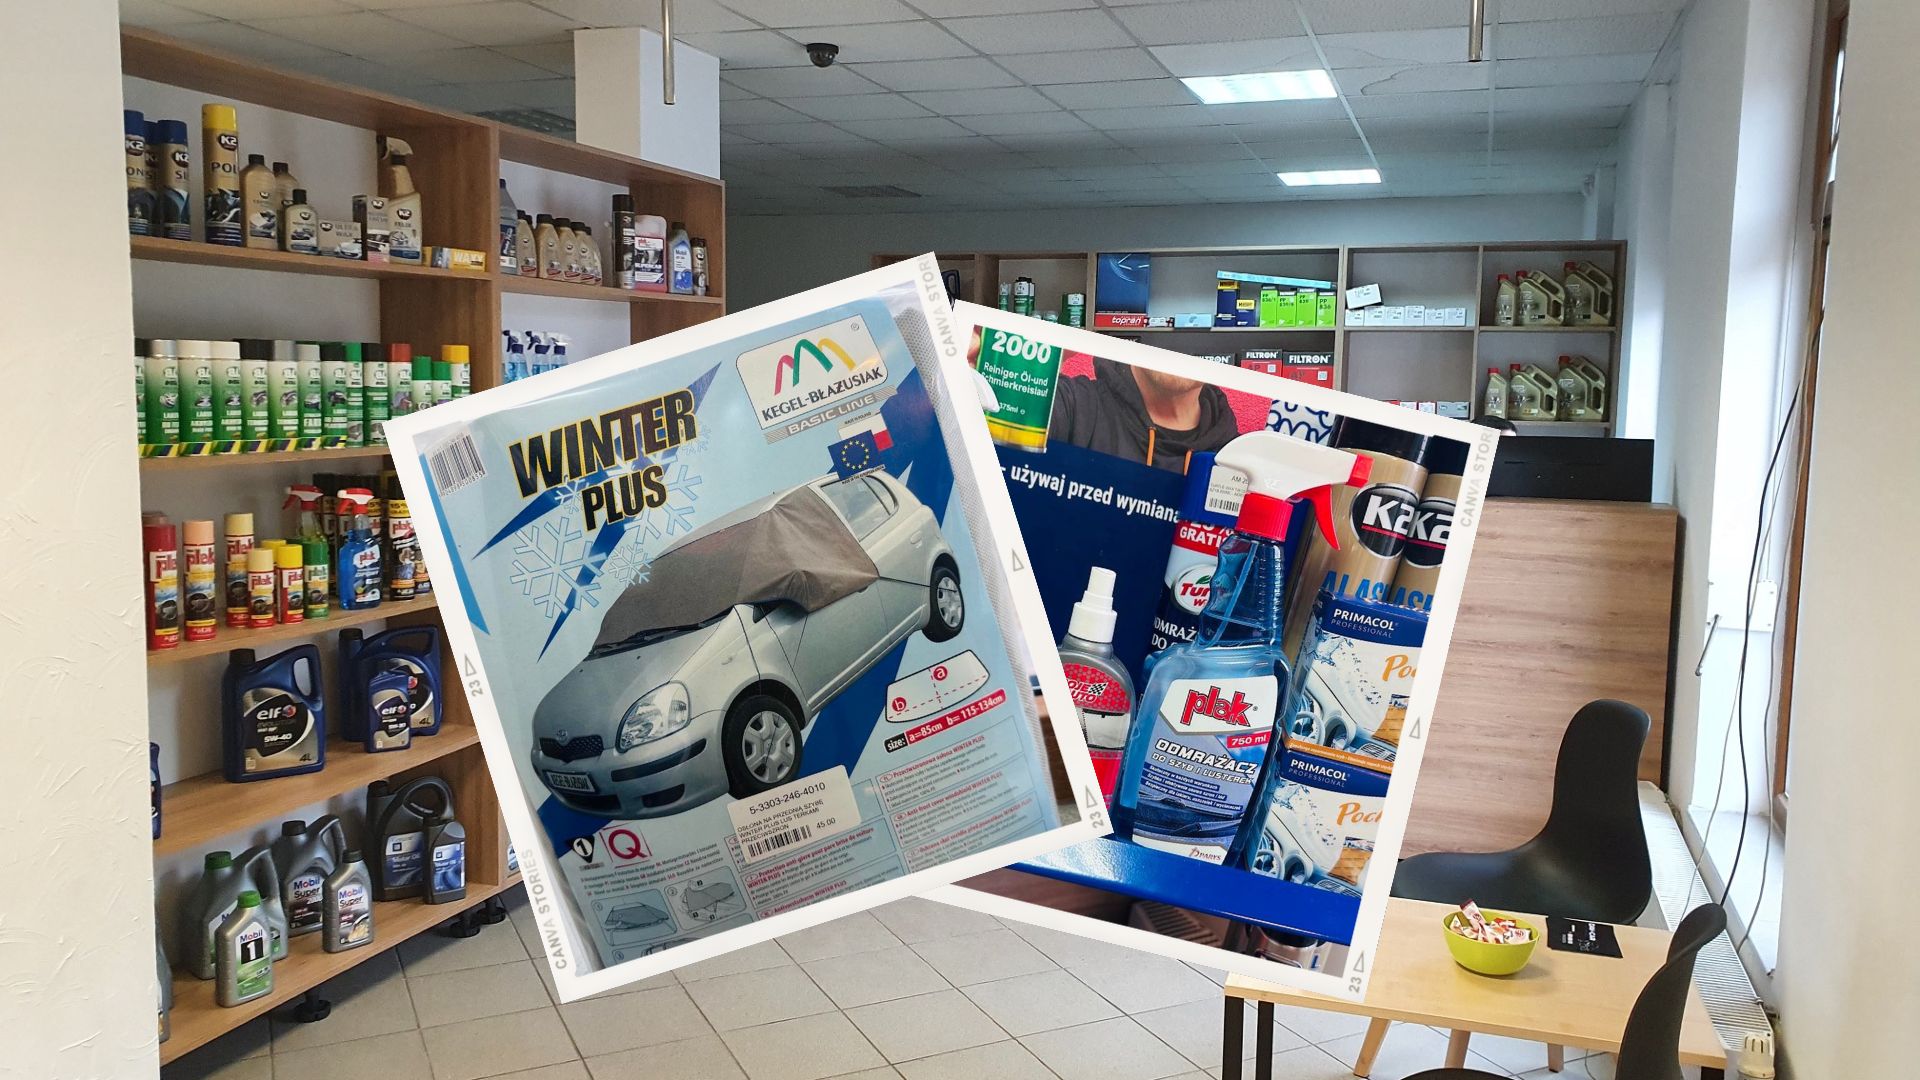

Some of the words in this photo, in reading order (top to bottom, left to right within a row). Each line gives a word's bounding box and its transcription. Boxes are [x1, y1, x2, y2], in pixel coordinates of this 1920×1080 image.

[125, 140, 144, 150] K2
[220, 135, 237, 146] K2
[1112, 315, 1142, 325] topran
[992, 330, 1052, 364] 2000
[1246, 351, 1277, 359] FILTRON
[1288, 354, 1329, 364] FILTRON
[984, 362, 1019, 380] Reiniger
[1020, 370, 1049, 387] Öl-und
[788, 409, 836, 435] BASIC
[838, 394, 876, 413] LINE
[509, 388, 697, 499] WINTER
[1010, 465, 1066, 498] używaj
[1067, 481, 1114, 506] przed
[581, 465, 668, 532] PLUS
[1363, 494, 1415, 536] K2
[1409, 510, 1453, 545] K2
[186, 549, 216, 574] plak
[251, 574, 273, 590] plak
[1180, 582, 1210, 597] Tur
[1321, 570, 1390, 601] ALAS
[1333, 608, 1395, 631] PRIMACOL
[1154, 616, 1198, 643] DMRAŻ
[1331, 618, 1393, 639] PROFESSIONAL
[1151, 634, 1167, 650] DO
[1067, 679, 1091, 693] OJE
[1072, 690, 1099, 703] UTO
[257, 707, 282, 720] elf
[382, 707, 397, 715] elf
[1180, 685, 1253, 728] plak
[264, 733, 293, 743] 5W-40
[887, 737, 906, 751] size:
[952, 741, 973, 753] WINTER
[972, 735, 985, 745] PLUS
[1230, 736, 1252, 747] 750
[1254, 734, 1267, 743] ml
[299, 752, 312, 762] 4L
[1155, 738, 1258, 775] ODMRAŻACZ
[1152, 752, 1166, 763] DO
[1168, 757, 1195, 772] SZYB
[1203, 768, 1253, 785] LUSTEREK
[1290, 758, 1348, 782] PRIMACOL
[1288, 768, 1346, 788] PROFESSIONAL
[749, 781, 826, 815] 5-3303-246-4010
[739, 827, 763, 839] WINTER
[763, 820, 780, 831] PLUS
[816, 817, 836, 830] 45.00
[608, 829, 649, 860] Q
[758, 861, 786, 878] Protection
[767, 872, 781, 883] PLUS
[294, 876, 321, 890] Mobil
[294, 887, 321, 899] Super
[339, 887, 363, 900] Mobil
[339, 895, 364, 908] Super
[239, 929, 263, 944] Mobil
